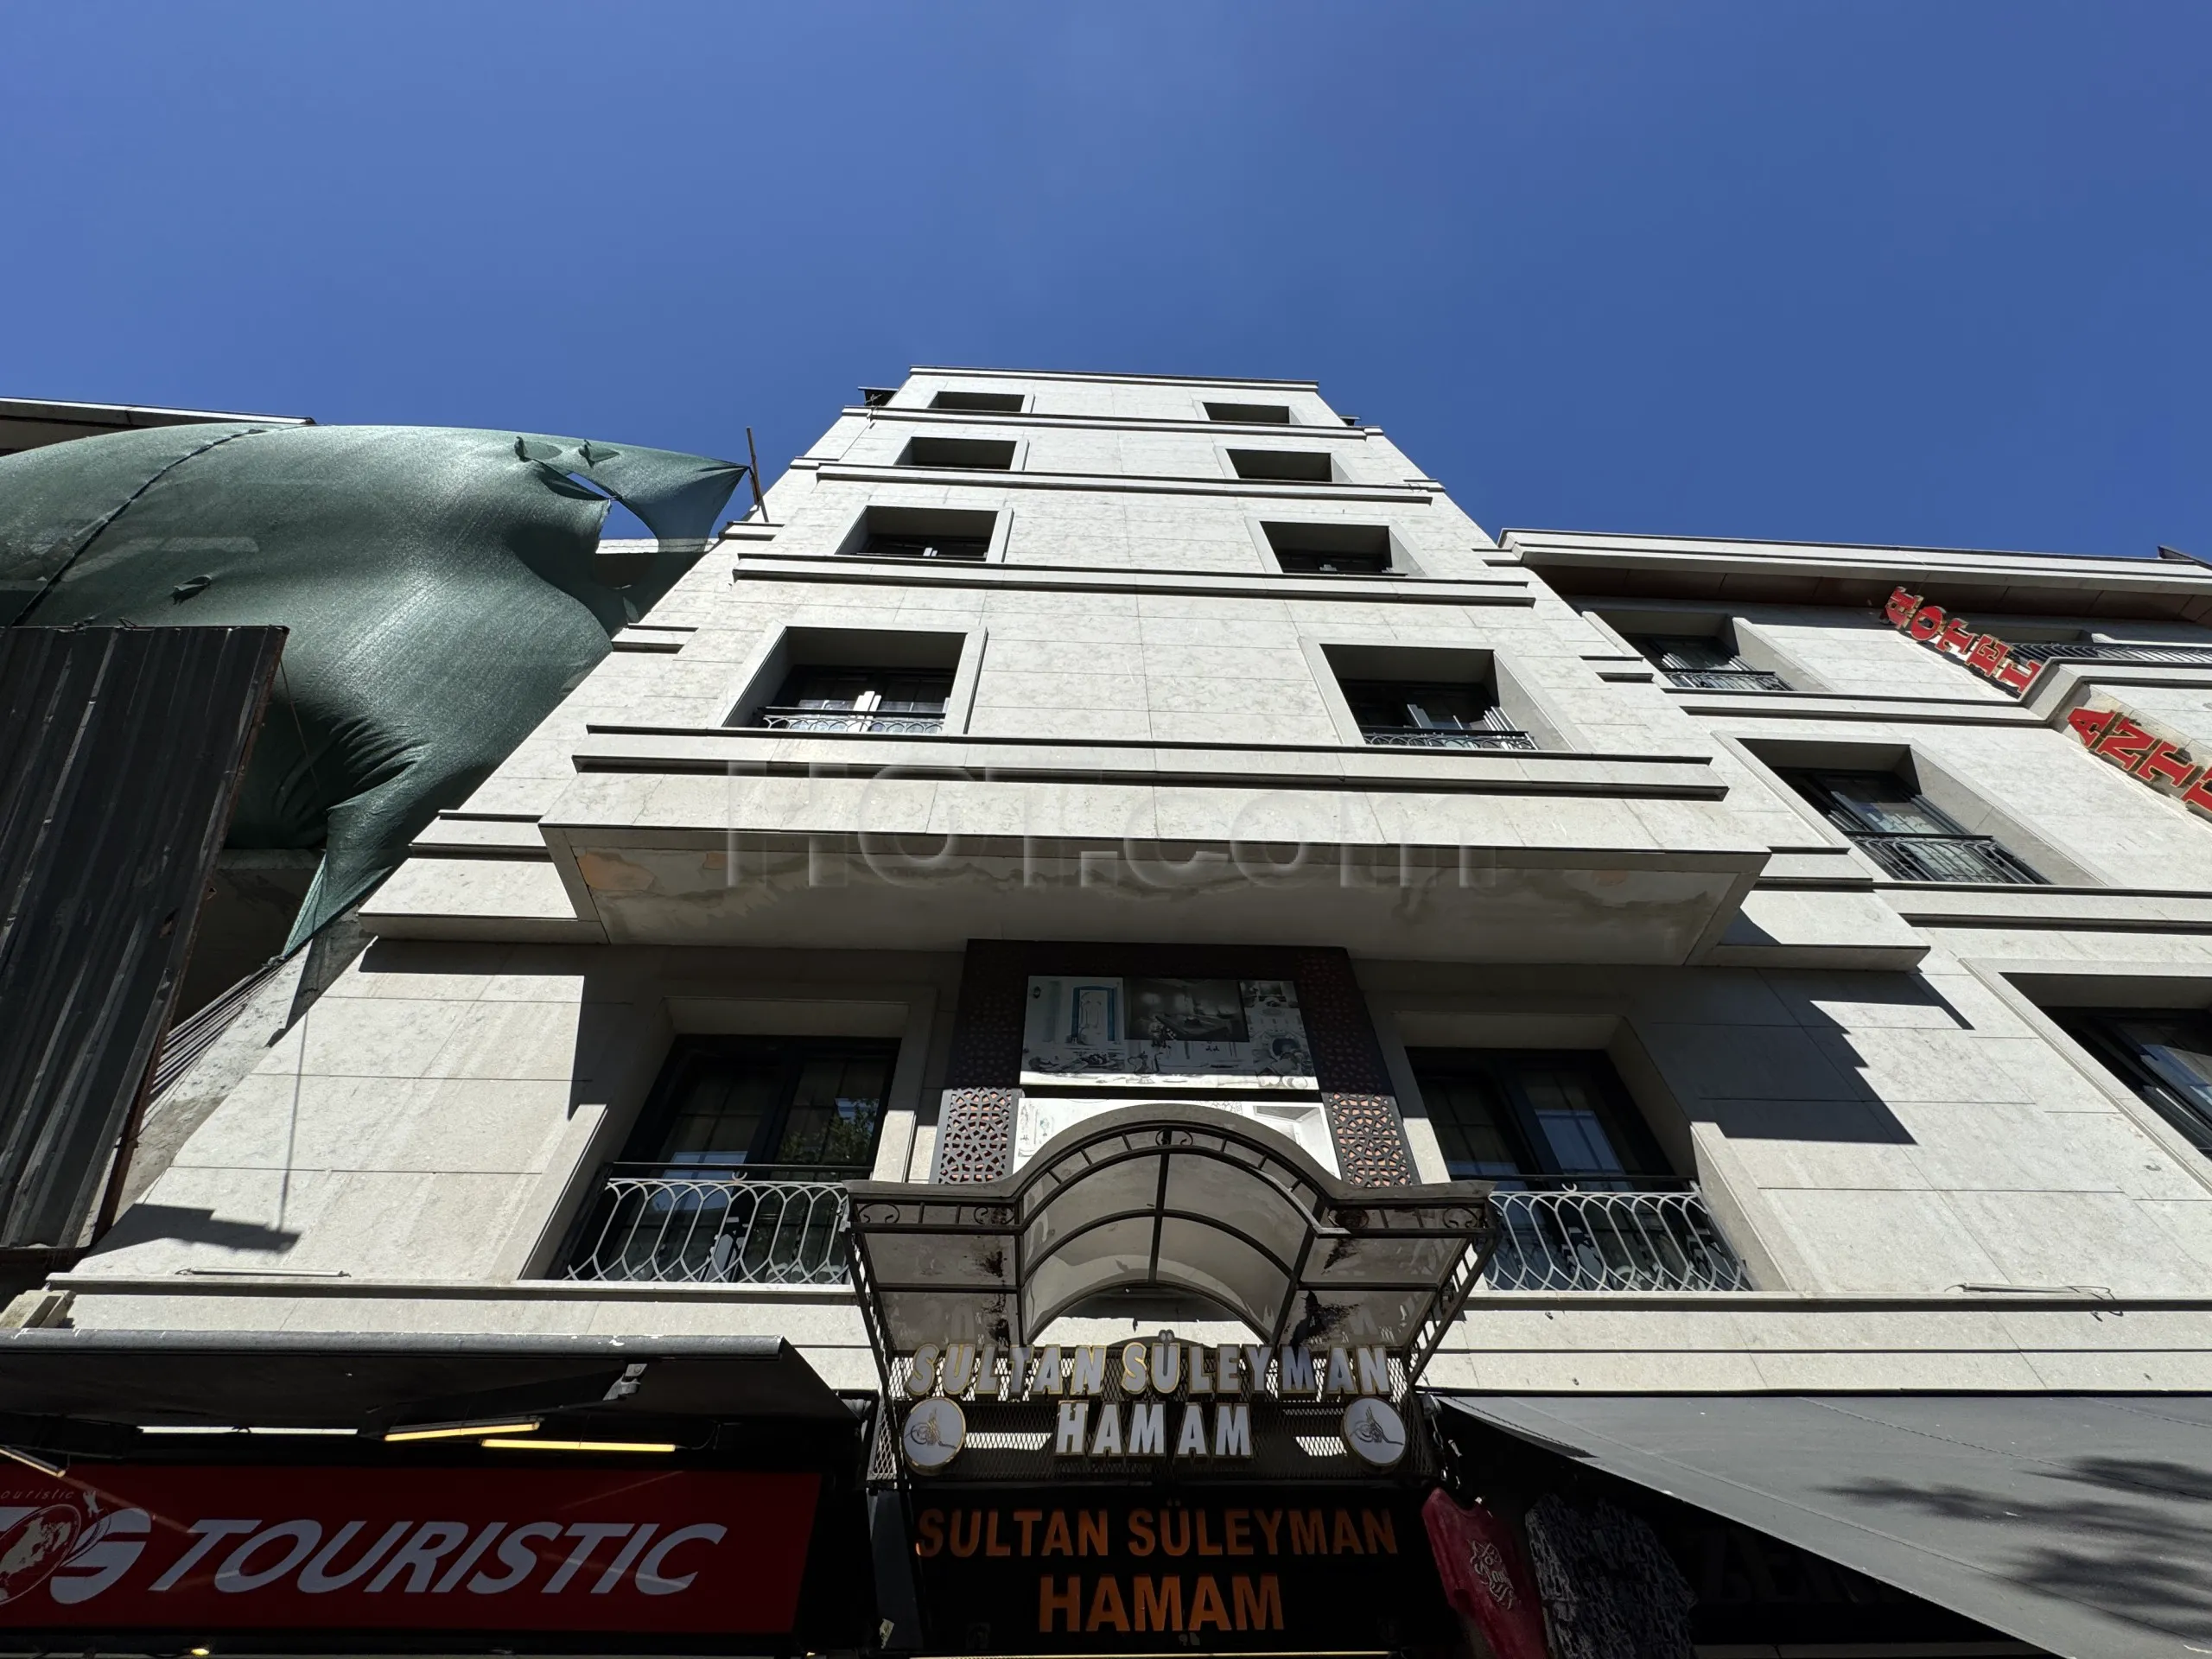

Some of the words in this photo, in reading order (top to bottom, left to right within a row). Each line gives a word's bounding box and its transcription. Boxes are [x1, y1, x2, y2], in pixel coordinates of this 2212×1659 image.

[1880, 586, 2044, 692] HOTEL
[907, 1344, 1106, 1396] SULTAN
[1122, 1330, 1390, 1395] SÜLEYMAN
[1056, 1401, 1253, 1459] HAMAM
[149, 1518, 728, 1595] TOURISTIC
[918, 1510, 1109, 1556] SULTAN
[1128, 1498, 1397, 1555] SÜLEYMAN
[1039, 1574, 1284, 1631] HAMAM
